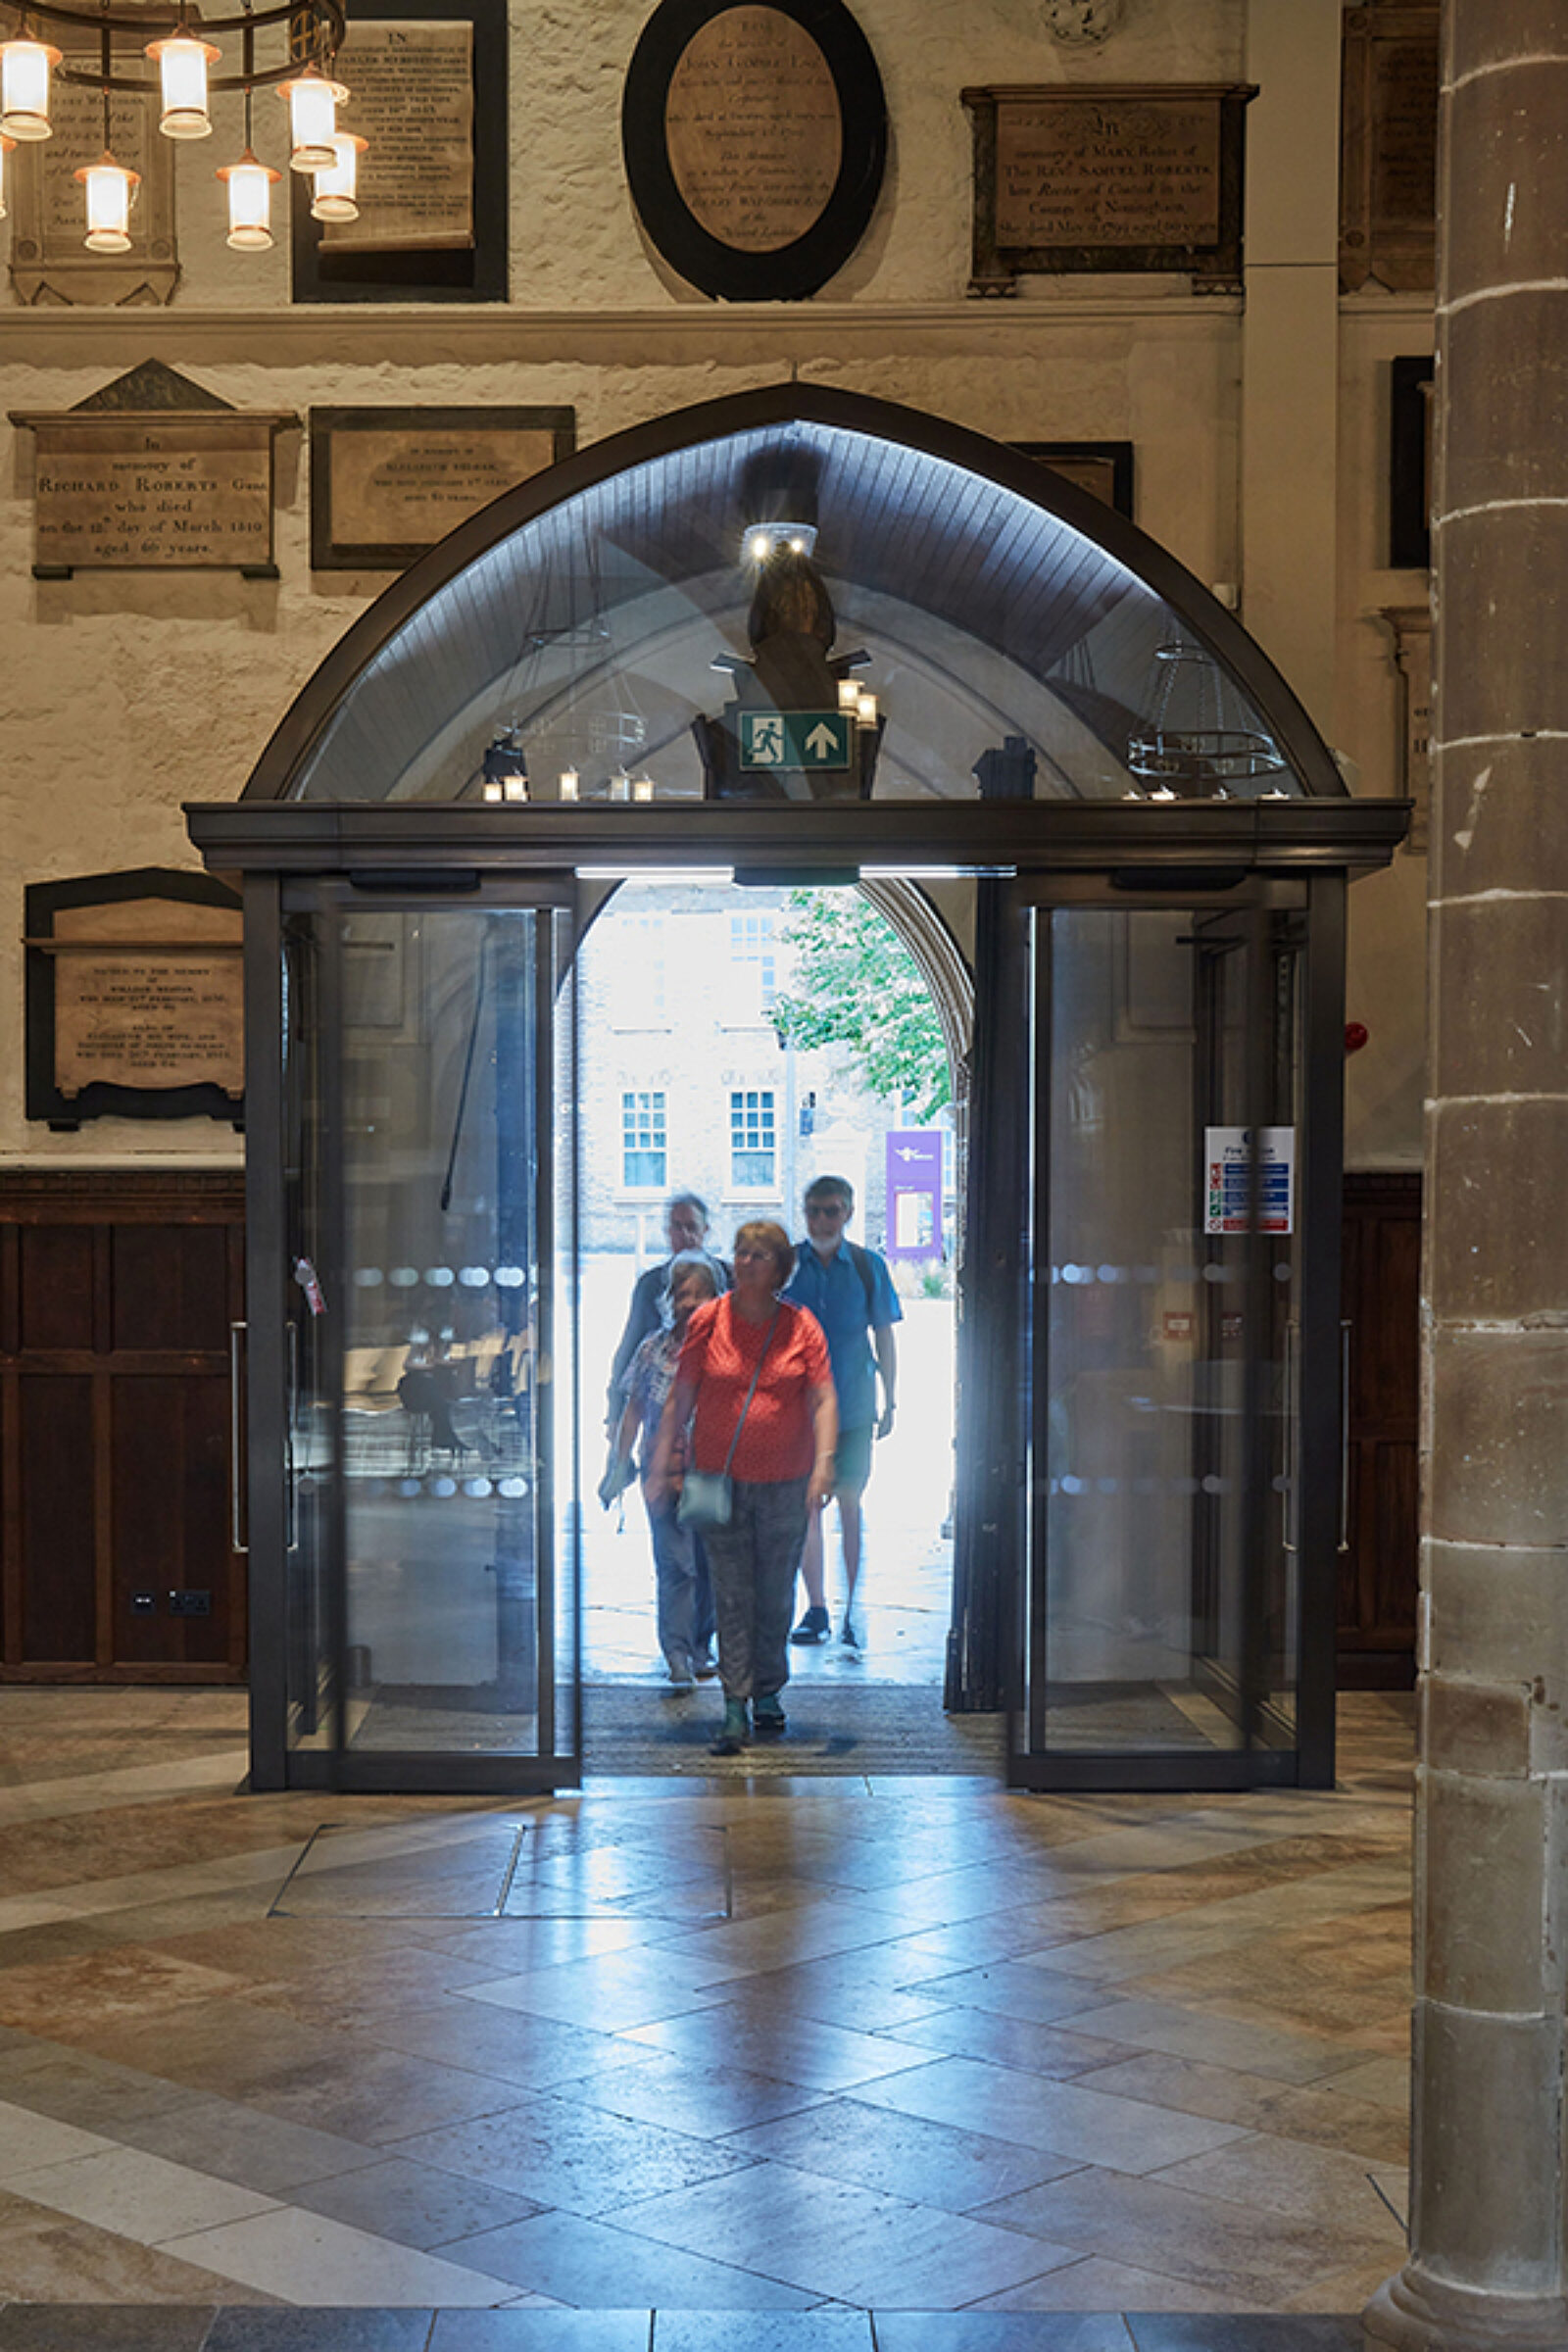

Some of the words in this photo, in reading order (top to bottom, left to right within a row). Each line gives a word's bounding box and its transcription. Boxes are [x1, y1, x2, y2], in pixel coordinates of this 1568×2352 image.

[112, 461, 171, 474] memory
[179, 457, 196, 471] of
[38, 477, 121, 492] RICHARD
[136, 477, 218, 492] ROBERTS
[115, 499, 147, 513] who
[156, 499, 193, 513] died
[117, 520, 140, 538] day
[149, 519, 169, 534] of
[172, 519, 223, 534] March
[94, 542, 129, 558] aged
